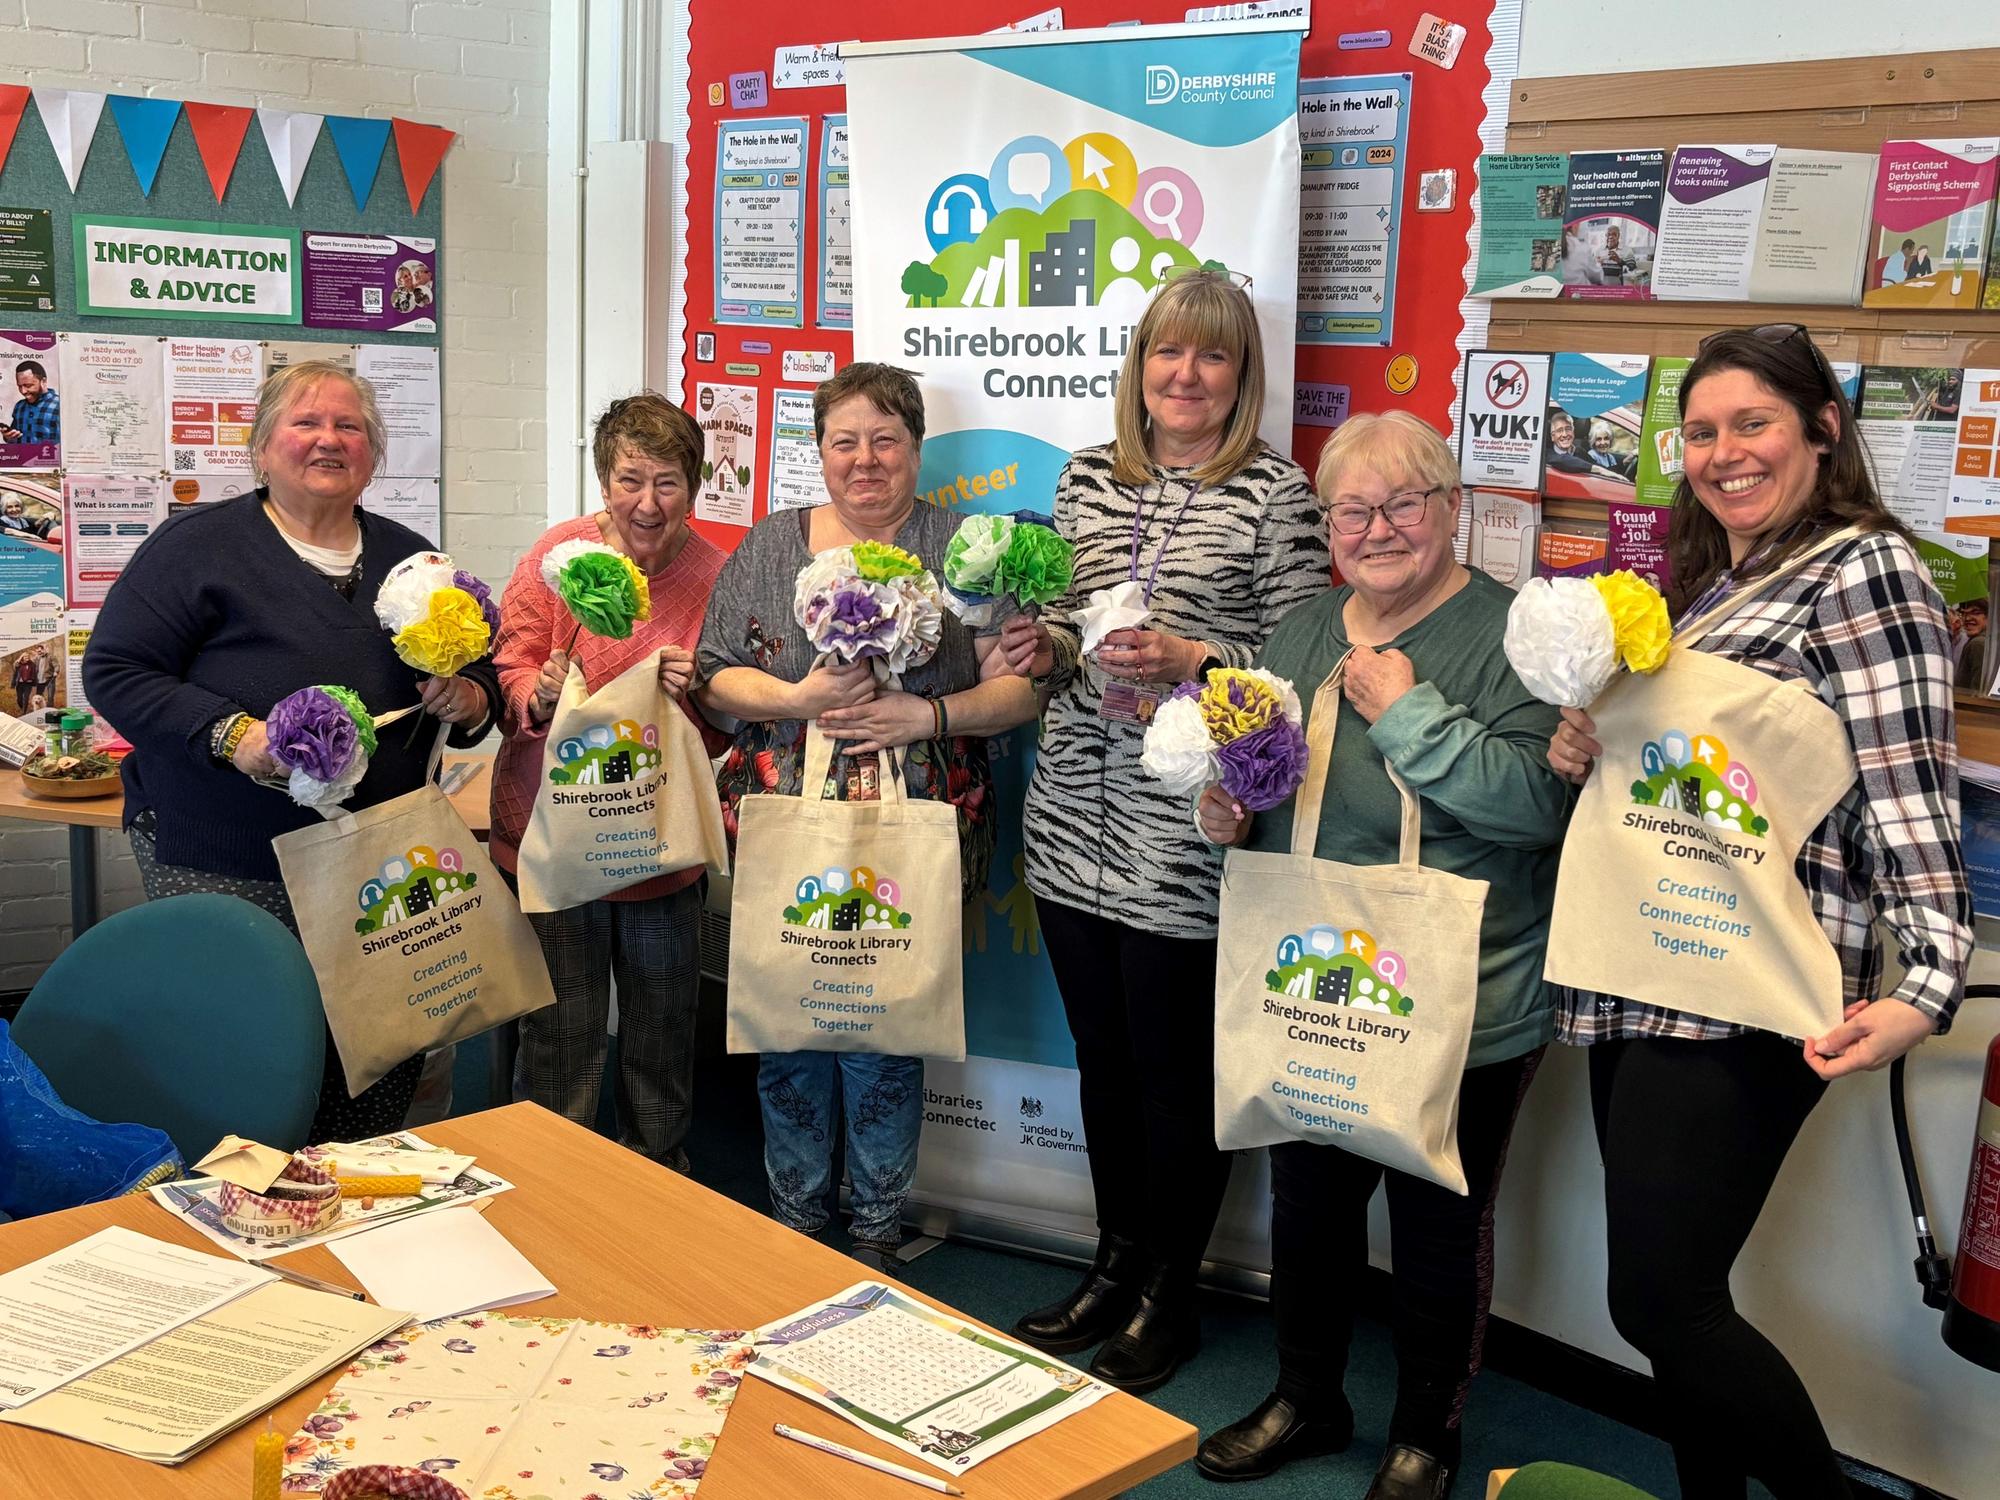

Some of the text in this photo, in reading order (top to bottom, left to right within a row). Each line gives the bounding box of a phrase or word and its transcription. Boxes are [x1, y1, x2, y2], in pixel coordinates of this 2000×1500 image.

[1431, 23, 1445, 35] IT'S
[1426, 33, 1449, 48] BLAST
[785, 50, 818, 64] Warm &
[1420, 43, 1446, 61] THING
[736, 77, 760, 90] CRAFTY
[803, 69, 829, 84] spaces
[1182, 72, 1276, 89] DERBYSHIRE
[740, 89, 758, 101] CHAT
[1182, 89, 1226, 104] County
[1302, 95, 1393, 114] Hole in the Wall
[836, 132, 848, 141] The
[1311, 127, 1327, 137] kind
[1327, 128, 1334, 137] in
[730, 134, 797, 146] The Hole in the Wall
[1370, 150, 1391, 158] 2024
[1617, 153, 1662, 162] healthwatch
[1509, 162, 1534, 171] Library
[1679, 157, 1722, 167] Renewing
[1890, 160, 1949, 170] First Contact
[1593, 171, 1619, 179] health
[1621, 171, 1638, 179] and
[1677, 167, 1727, 178] your library
[1888, 172, 1938, 182] Derbyshire
[1337, 182, 1360, 190] FRIDGE
[1572, 181, 1596, 190] social
[1617, 179, 1660, 189] champion
[1674, 177, 1729, 187] books online
[1887, 180, 1980, 192] Signposting Scheme
[1305, 212, 1348, 221] 09:30 11:00
[310, 240, 332, 248] Support
[364, 243, 392, 251] Derbyshire
[95, 242, 287, 272] INFORMATION
[130, 278, 256, 304] & ADVICE
[195, 345, 225, 353] Housing
[904, 326, 1086, 357] Shirebrook
[793, 359, 826, 373] blastland
[984, 369, 1119, 397] Connect
[1560, 377, 1580, 385] Driving
[1297, 389, 1344, 404] SAVE THE
[1300, 404, 1339, 418] PLANET
[701, 421, 752, 435] WARM SPACES
[1469, 413, 1540, 441] YUK!
[1967, 423, 1989, 431] Benefit
[926, 462, 1019, 508] unteer
[1493, 500, 1524, 511] Putting
[1484, 510, 1518, 529] first
[1613, 510, 1657, 525] found
[1627, 529, 1650, 542] job
[552, 771, 668, 805] Shirebrook Library
[589, 800, 655, 817] Connects
[596, 827, 657, 843] Creating
[585, 841, 669, 862] Connections
[600, 864, 663, 878] Together
[1657, 878, 1738, 911] Creating
[362, 894, 482, 955] Shirebrook Library
[1640, 902, 1751, 937] Connections
[401, 922, 462, 957] Connects
[781, 931, 911, 951] Shirebrook Library
[1652, 931, 1728, 960] Together
[413, 950, 468, 982] Creating
[811, 952, 877, 965] Connects
[408, 962, 483, 1006] Connections
[813, 980, 874, 997] Creating
[423, 987, 478, 1019] Together
[800, 997, 887, 1014] Connections
[812, 1017, 874, 1032] Together
[1263, 999, 1410, 1044] Shirebrook Library
[1288, 1025, 1366, 1053] Connects
[1286, 1060, 1357, 1090] Creating
[923, 1089, 983, 1111] ibraries
[1272, 1081, 1369, 1115] Connections
[1288, 1105, 1354, 1133] Together
[1060, 1127, 1074, 1141] by
[277, 1225, 291, 1234] LE
[781, 1312, 845, 1338] Mindfulness
